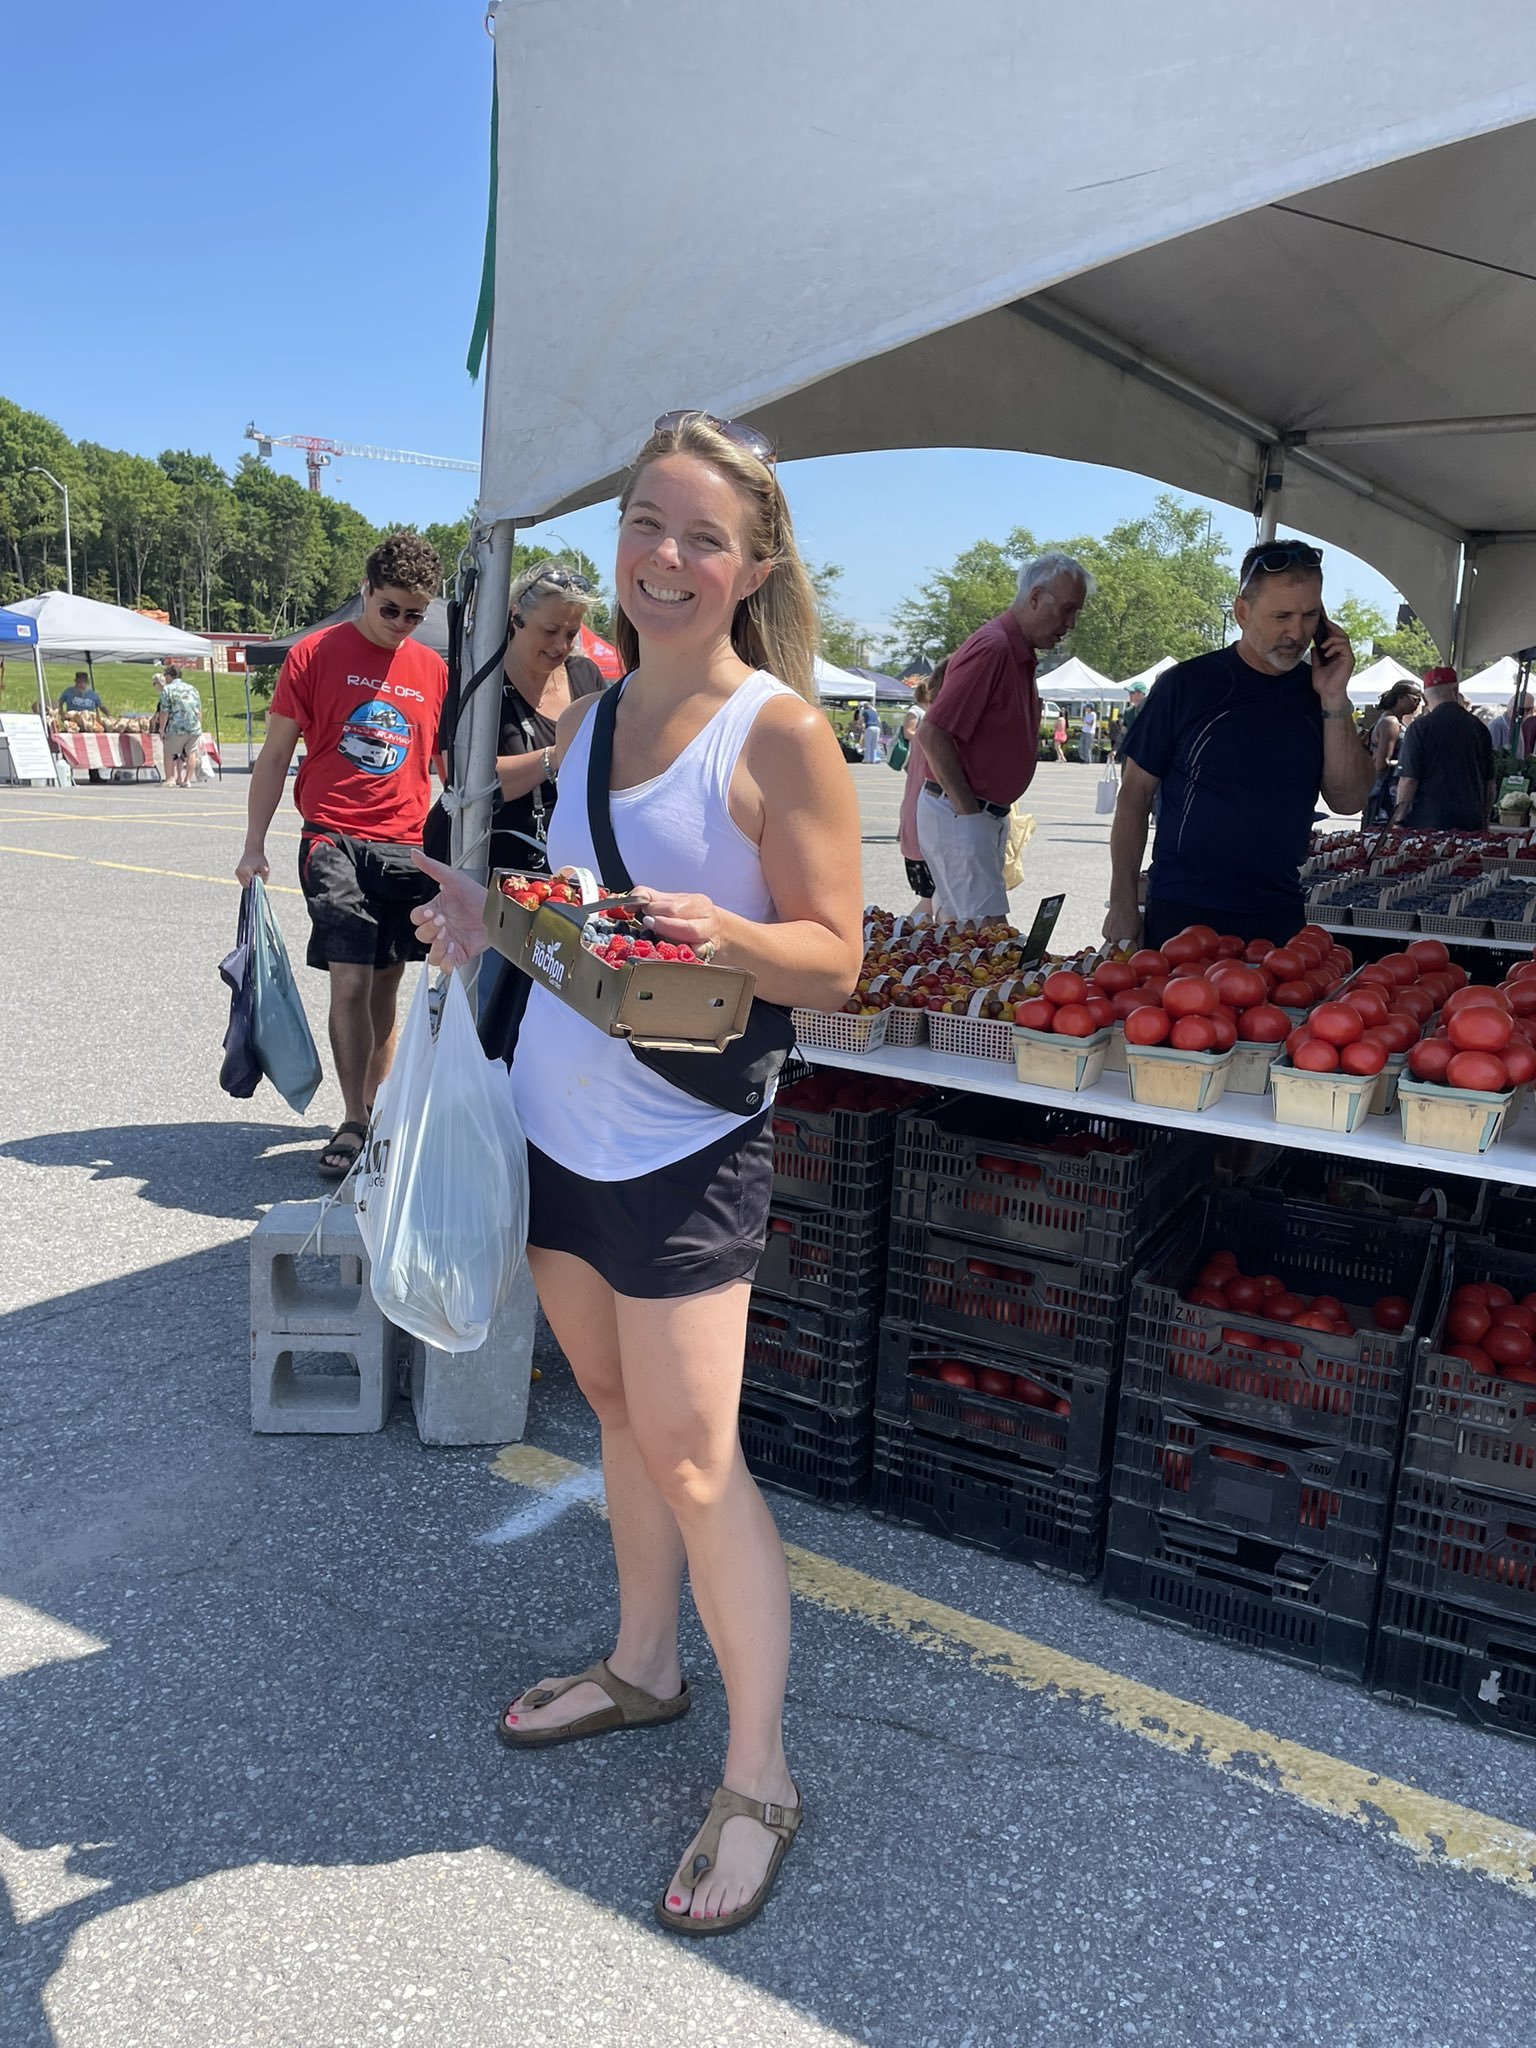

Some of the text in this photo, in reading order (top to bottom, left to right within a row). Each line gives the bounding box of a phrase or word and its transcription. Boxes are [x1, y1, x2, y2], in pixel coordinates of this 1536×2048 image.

[347, 675, 425, 703] RACE OPS
[531, 945, 566, 984] Rochon
[1307, 1462, 1332, 1476] ZMV
[1450, 1497, 1488, 1518] ZMV
